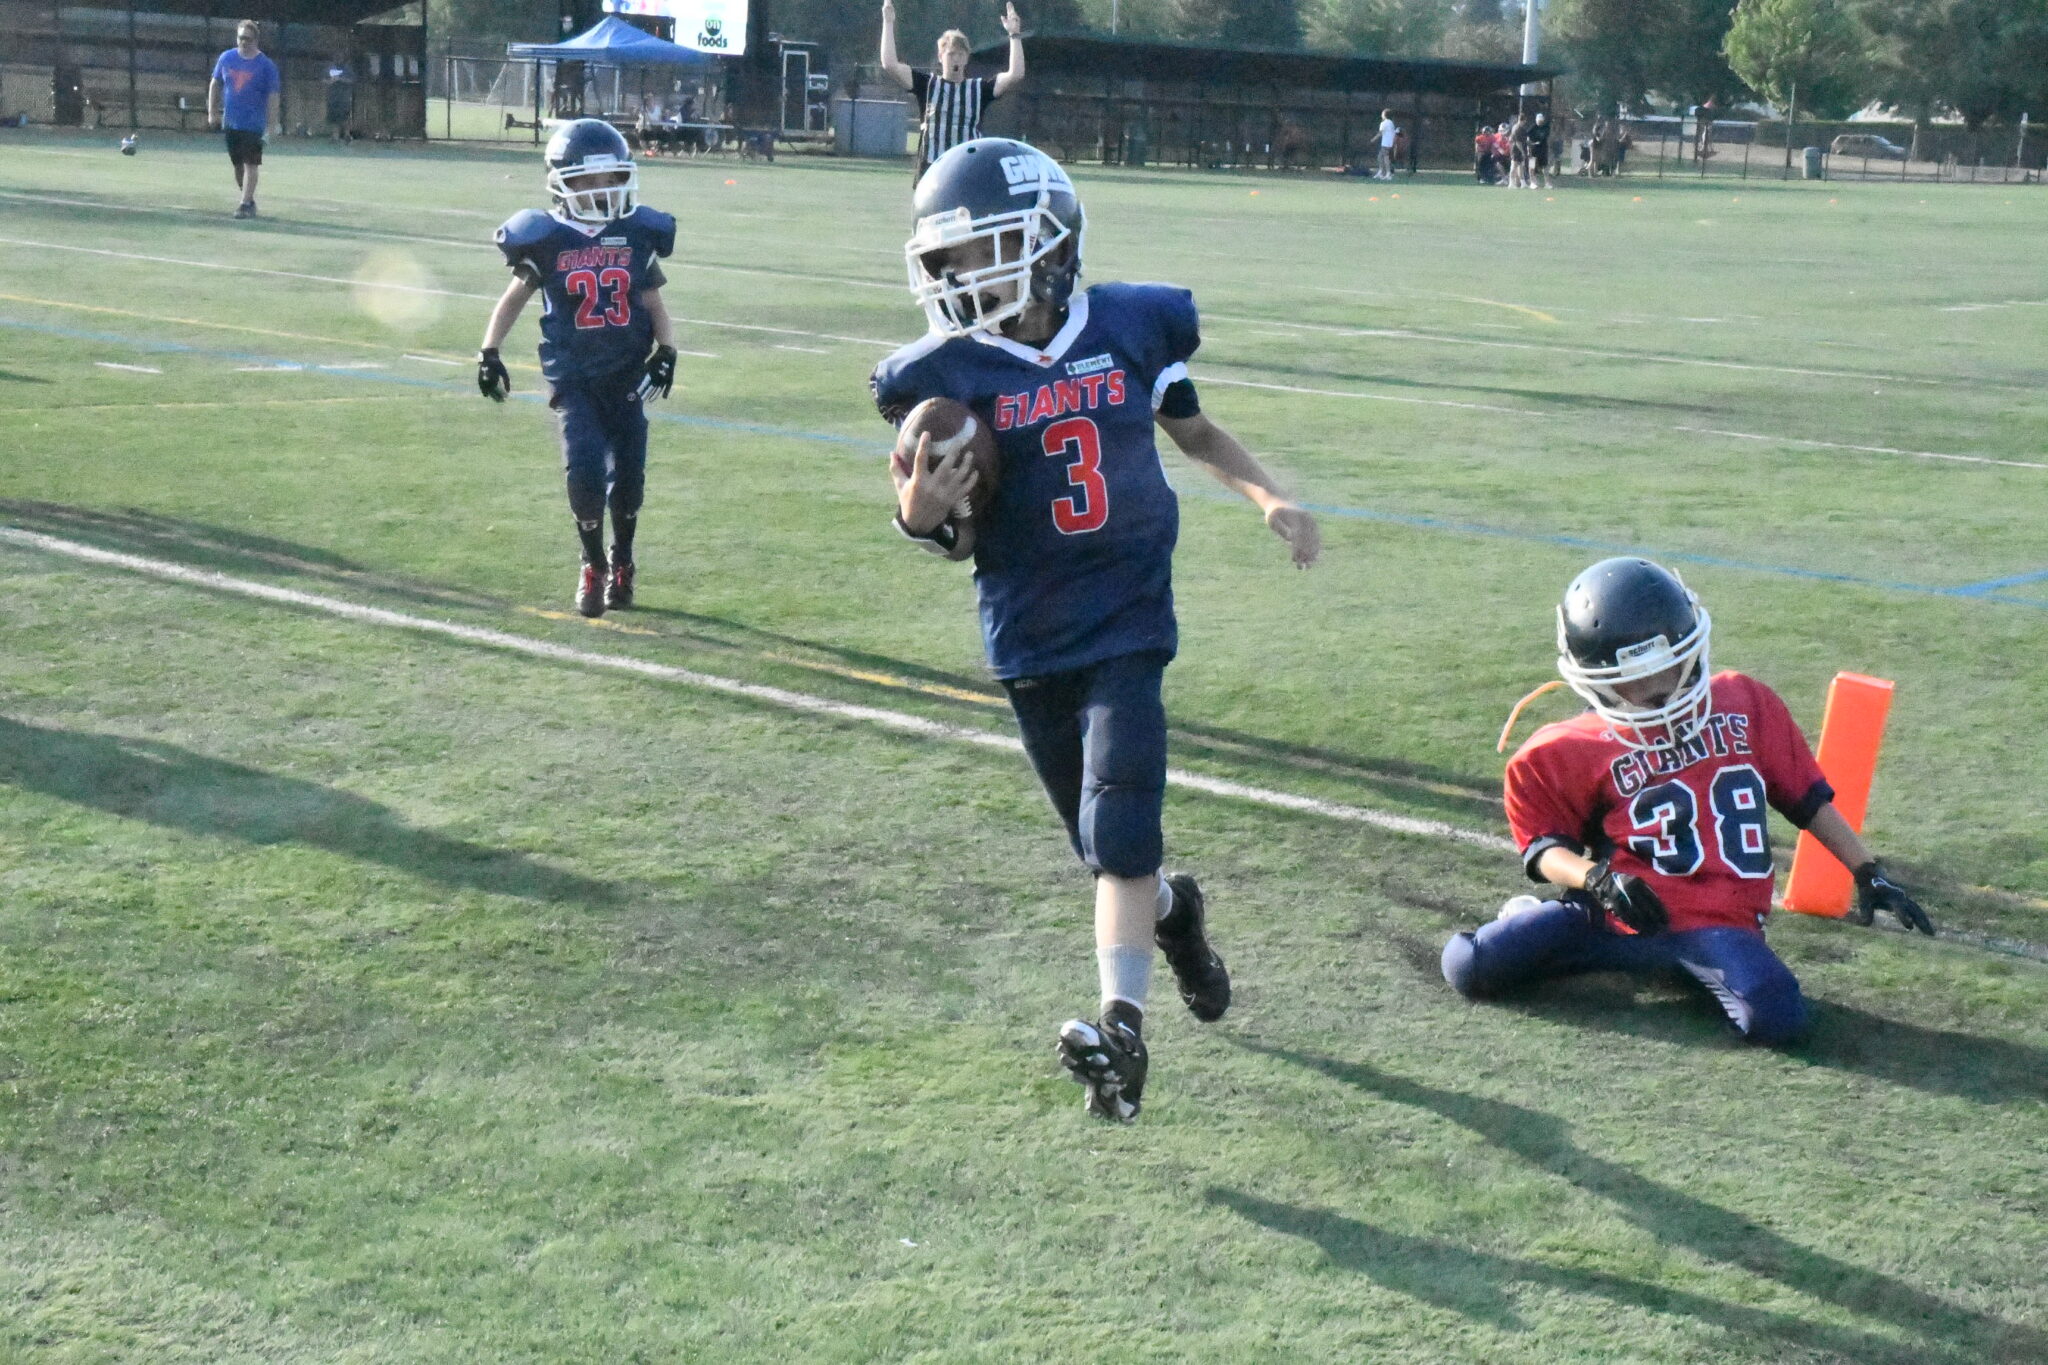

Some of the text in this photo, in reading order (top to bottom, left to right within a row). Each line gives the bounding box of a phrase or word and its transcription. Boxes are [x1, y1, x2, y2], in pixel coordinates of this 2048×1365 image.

[698, 32, 728, 48] foods
[557, 247, 633, 271] GIANTS
[566, 268, 631, 329] 23
[995, 370, 1125, 430] GIANTS
[1041, 416, 1109, 535] 3
[1610, 713, 1752, 797] GIANTS
[1628, 764, 1774, 878] 38
